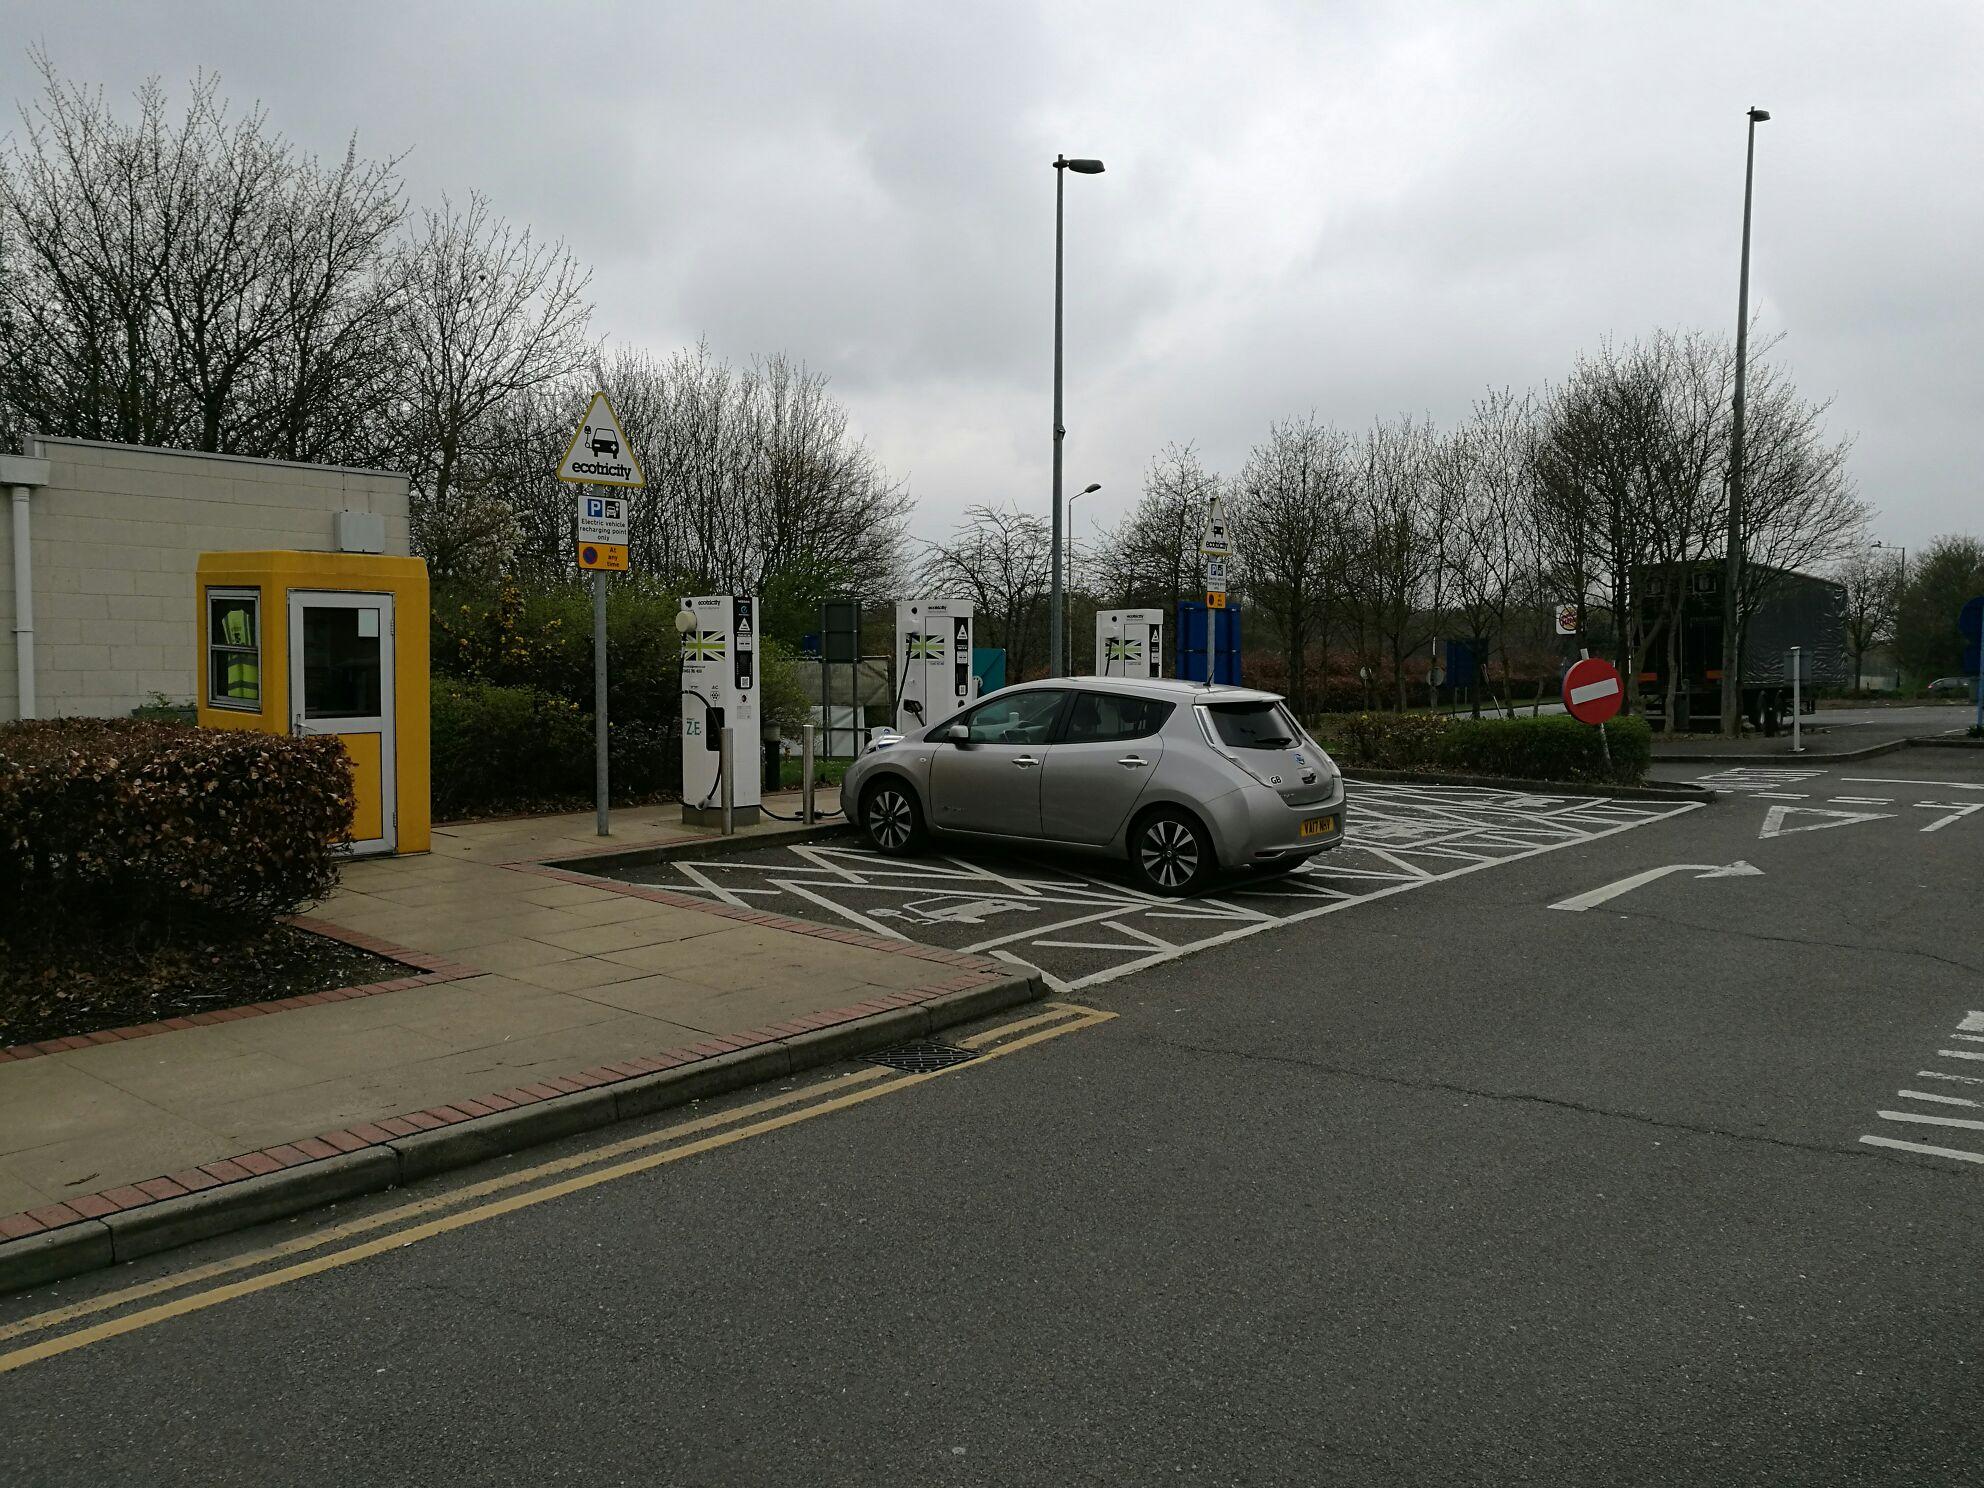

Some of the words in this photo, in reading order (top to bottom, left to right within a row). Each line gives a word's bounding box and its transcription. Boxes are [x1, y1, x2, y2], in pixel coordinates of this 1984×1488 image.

[572, 462, 632, 480] ecotricity
[591, 501, 601, 516] P
[581, 518, 604, 526] Electric
[605, 520, 626, 528] vehicle
[580, 526, 611, 534] recharging
[1206, 540, 1228, 551] ecotricity
[1270, 776, 1282, 784] GB
